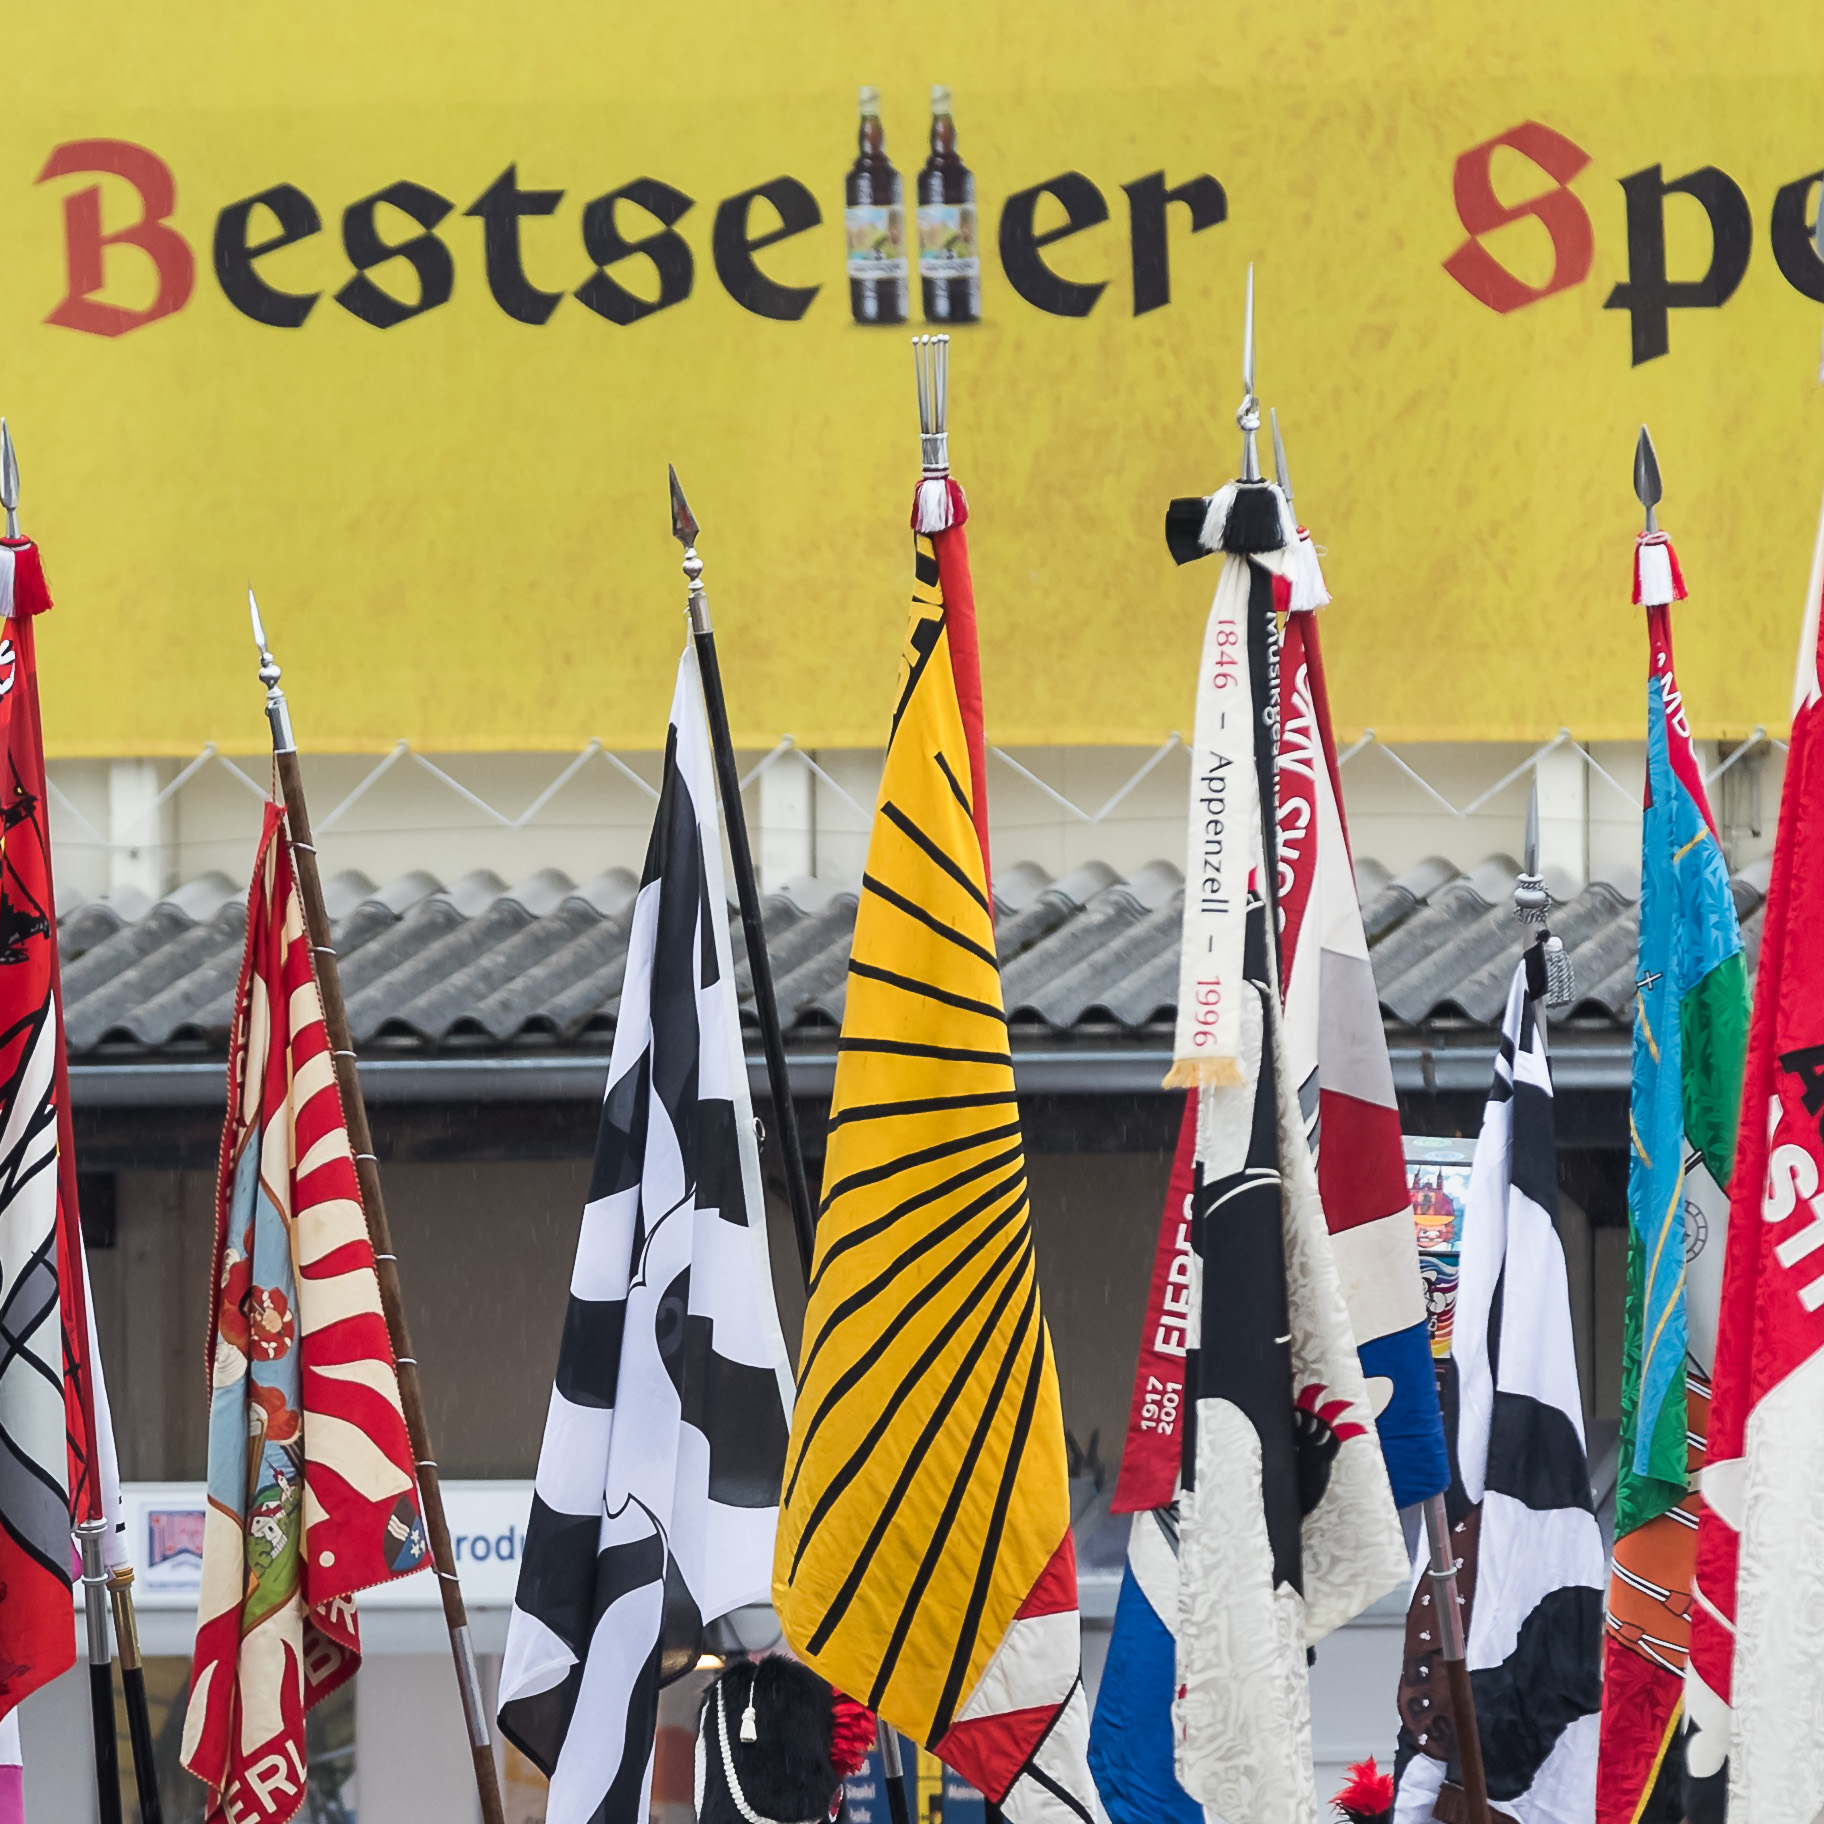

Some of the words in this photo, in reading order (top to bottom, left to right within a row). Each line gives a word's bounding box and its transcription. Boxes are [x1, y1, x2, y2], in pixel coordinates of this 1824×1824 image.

[1213, 619, 1239, 689] 1846
[1200, 751, 1235, 914] Appenzell
[1192, 976, 1223, 1048] 1996
[1141, 1375, 1164, 1431] 1917
[1157, 1381, 1183, 1436] 2001
